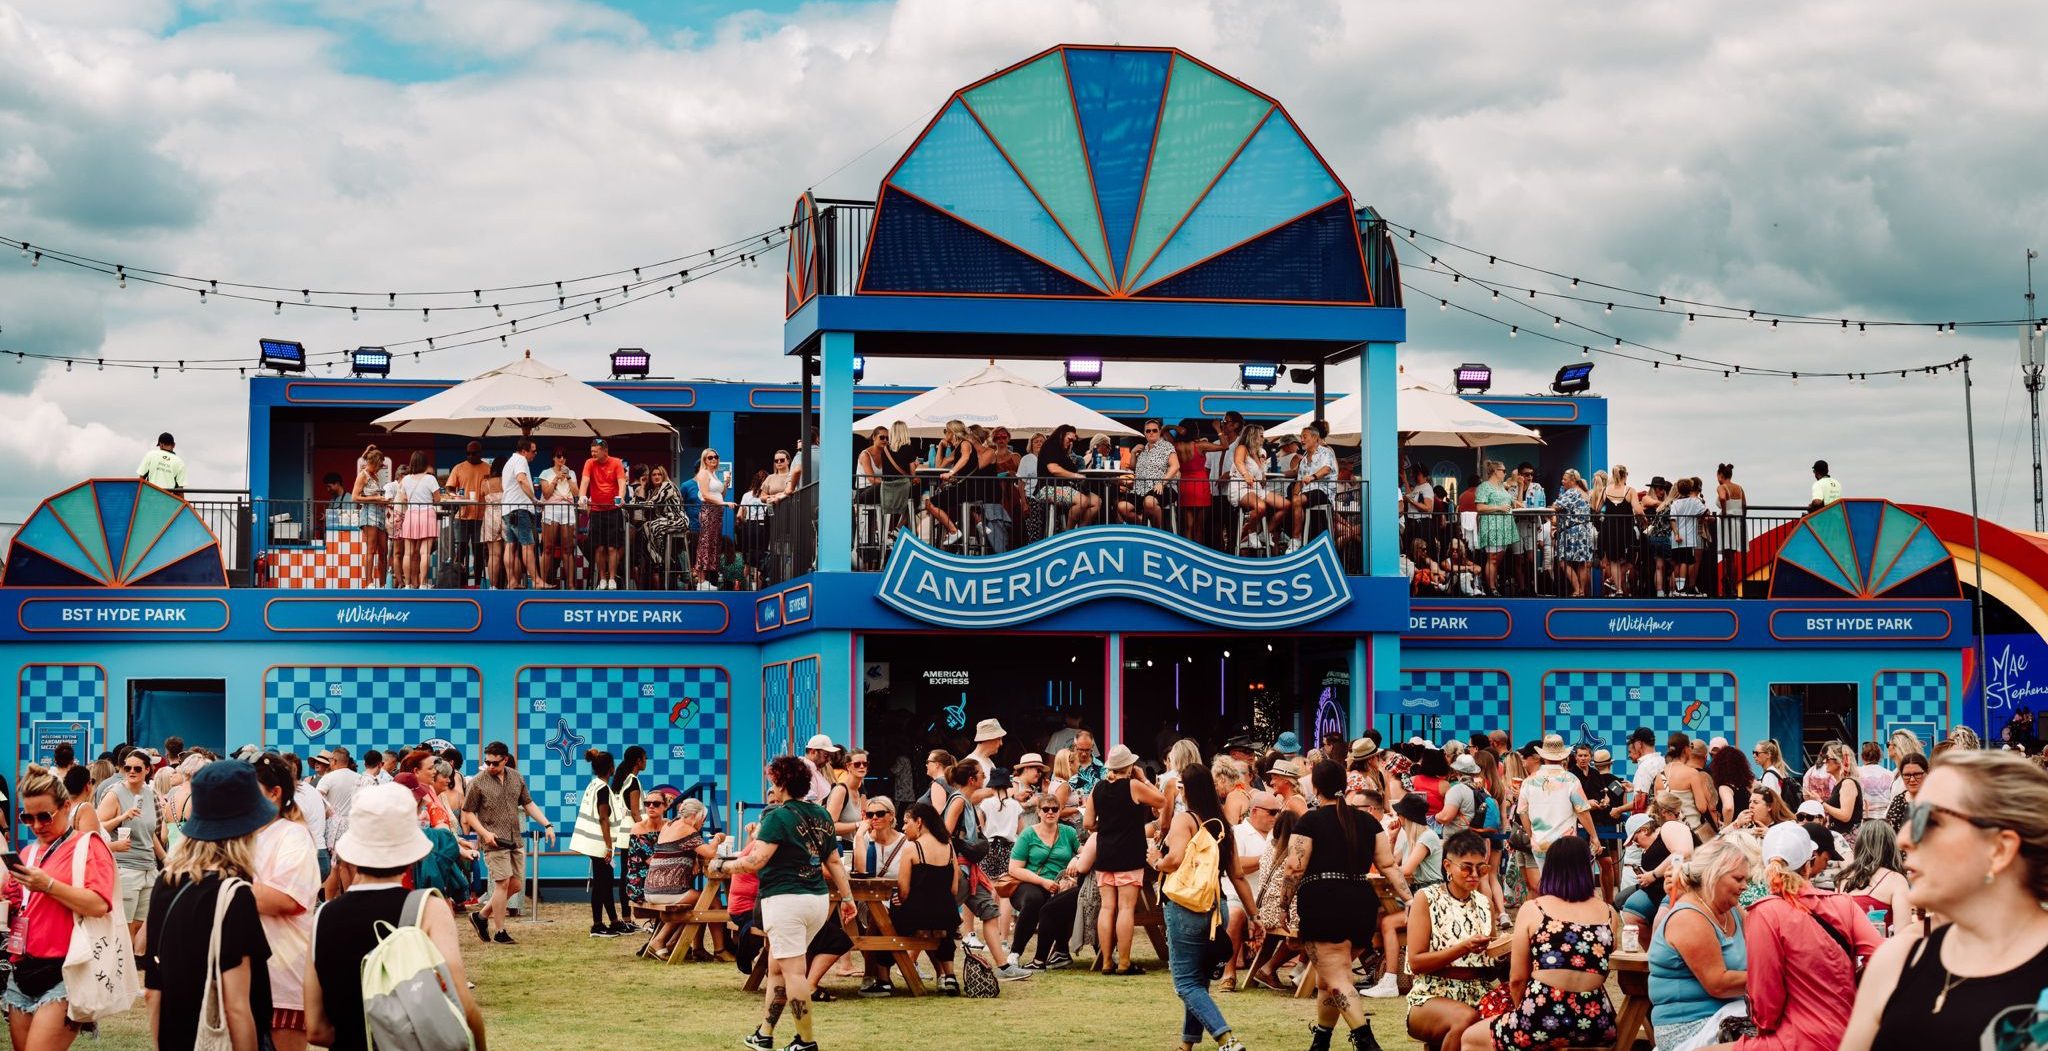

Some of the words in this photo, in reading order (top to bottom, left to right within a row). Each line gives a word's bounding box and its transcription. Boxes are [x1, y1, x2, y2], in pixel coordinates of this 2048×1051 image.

[916, 547, 1124, 605] AMERICAN
[1143, 550, 1313, 606] EXPRESS
[62, 608, 93, 621] BST
[97, 608, 140, 621] HYDE
[144, 608, 186, 621] PARK
[337, 605, 410, 624] #WithAmex
[564, 609, 594, 623] BST
[597, 609, 639, 623] HYDE
[643, 609, 683, 623] PARK
[1410, 617, 1428, 629] DE
[1432, 617, 1468, 629] PARK
[1608, 614, 1674, 633] #WithAmex
[1806, 618, 1834, 631] BST
[1836, 618, 1874, 631] HYDE
[1877, 618, 1913, 631] PARK
